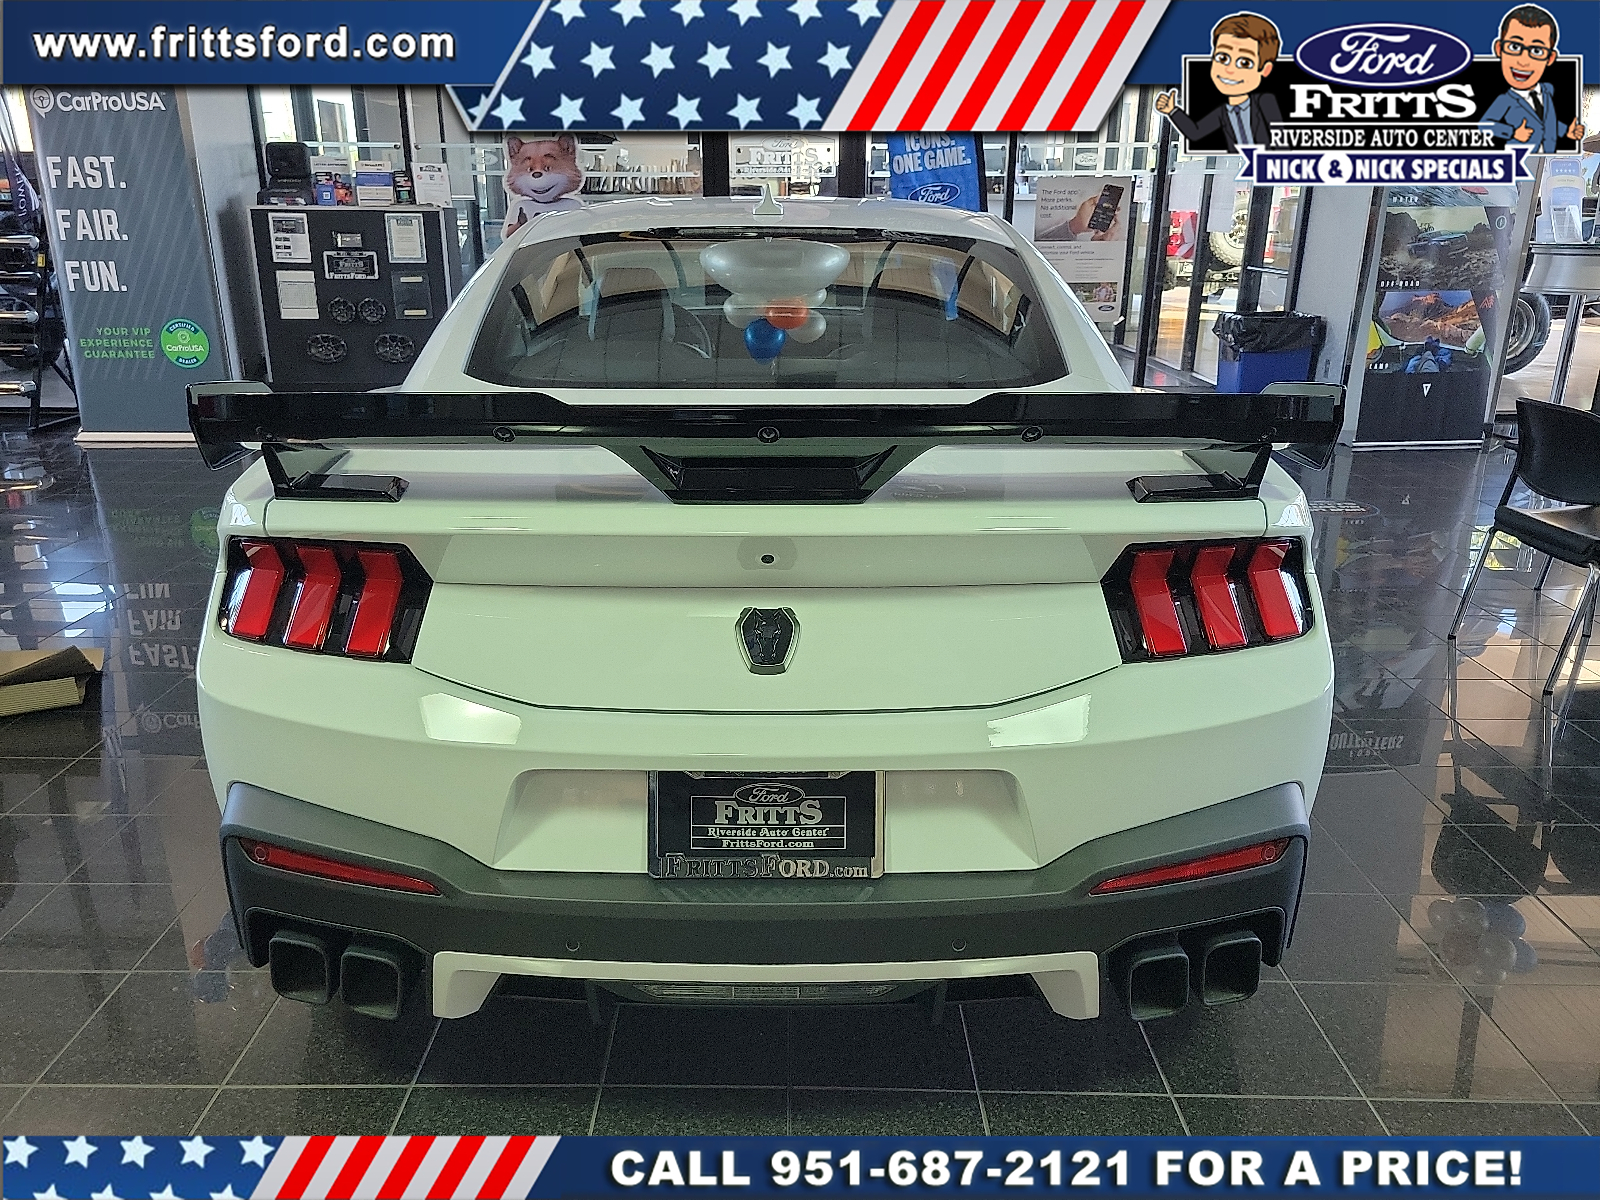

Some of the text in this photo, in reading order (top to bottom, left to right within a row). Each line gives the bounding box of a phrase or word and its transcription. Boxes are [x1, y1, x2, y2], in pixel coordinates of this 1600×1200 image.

[56, 91, 166, 112] CarProUSA
[904, 130, 956, 152] ICONS.
[892, 145, 972, 175] ONE GAME.
[46, 156, 127, 189] FAST.
[918, 186, 951, 203] Ford
[56, 209, 128, 240] FAIR.
[65, 261, 127, 291] FUN.
[96, 327, 151, 336] YOUR VIP
[80, 338, 154, 348] EXPERIENCE
[166, 343, 205, 353] CarProUSA
[84, 350, 156, 359] GUARANTEE
[748, 786, 790, 803] Ford
[714, 799, 823, 825] FRITTS
[707, 827, 830, 838] Riverside Auto Center
[721, 839, 815, 848] FrittsFord.com
